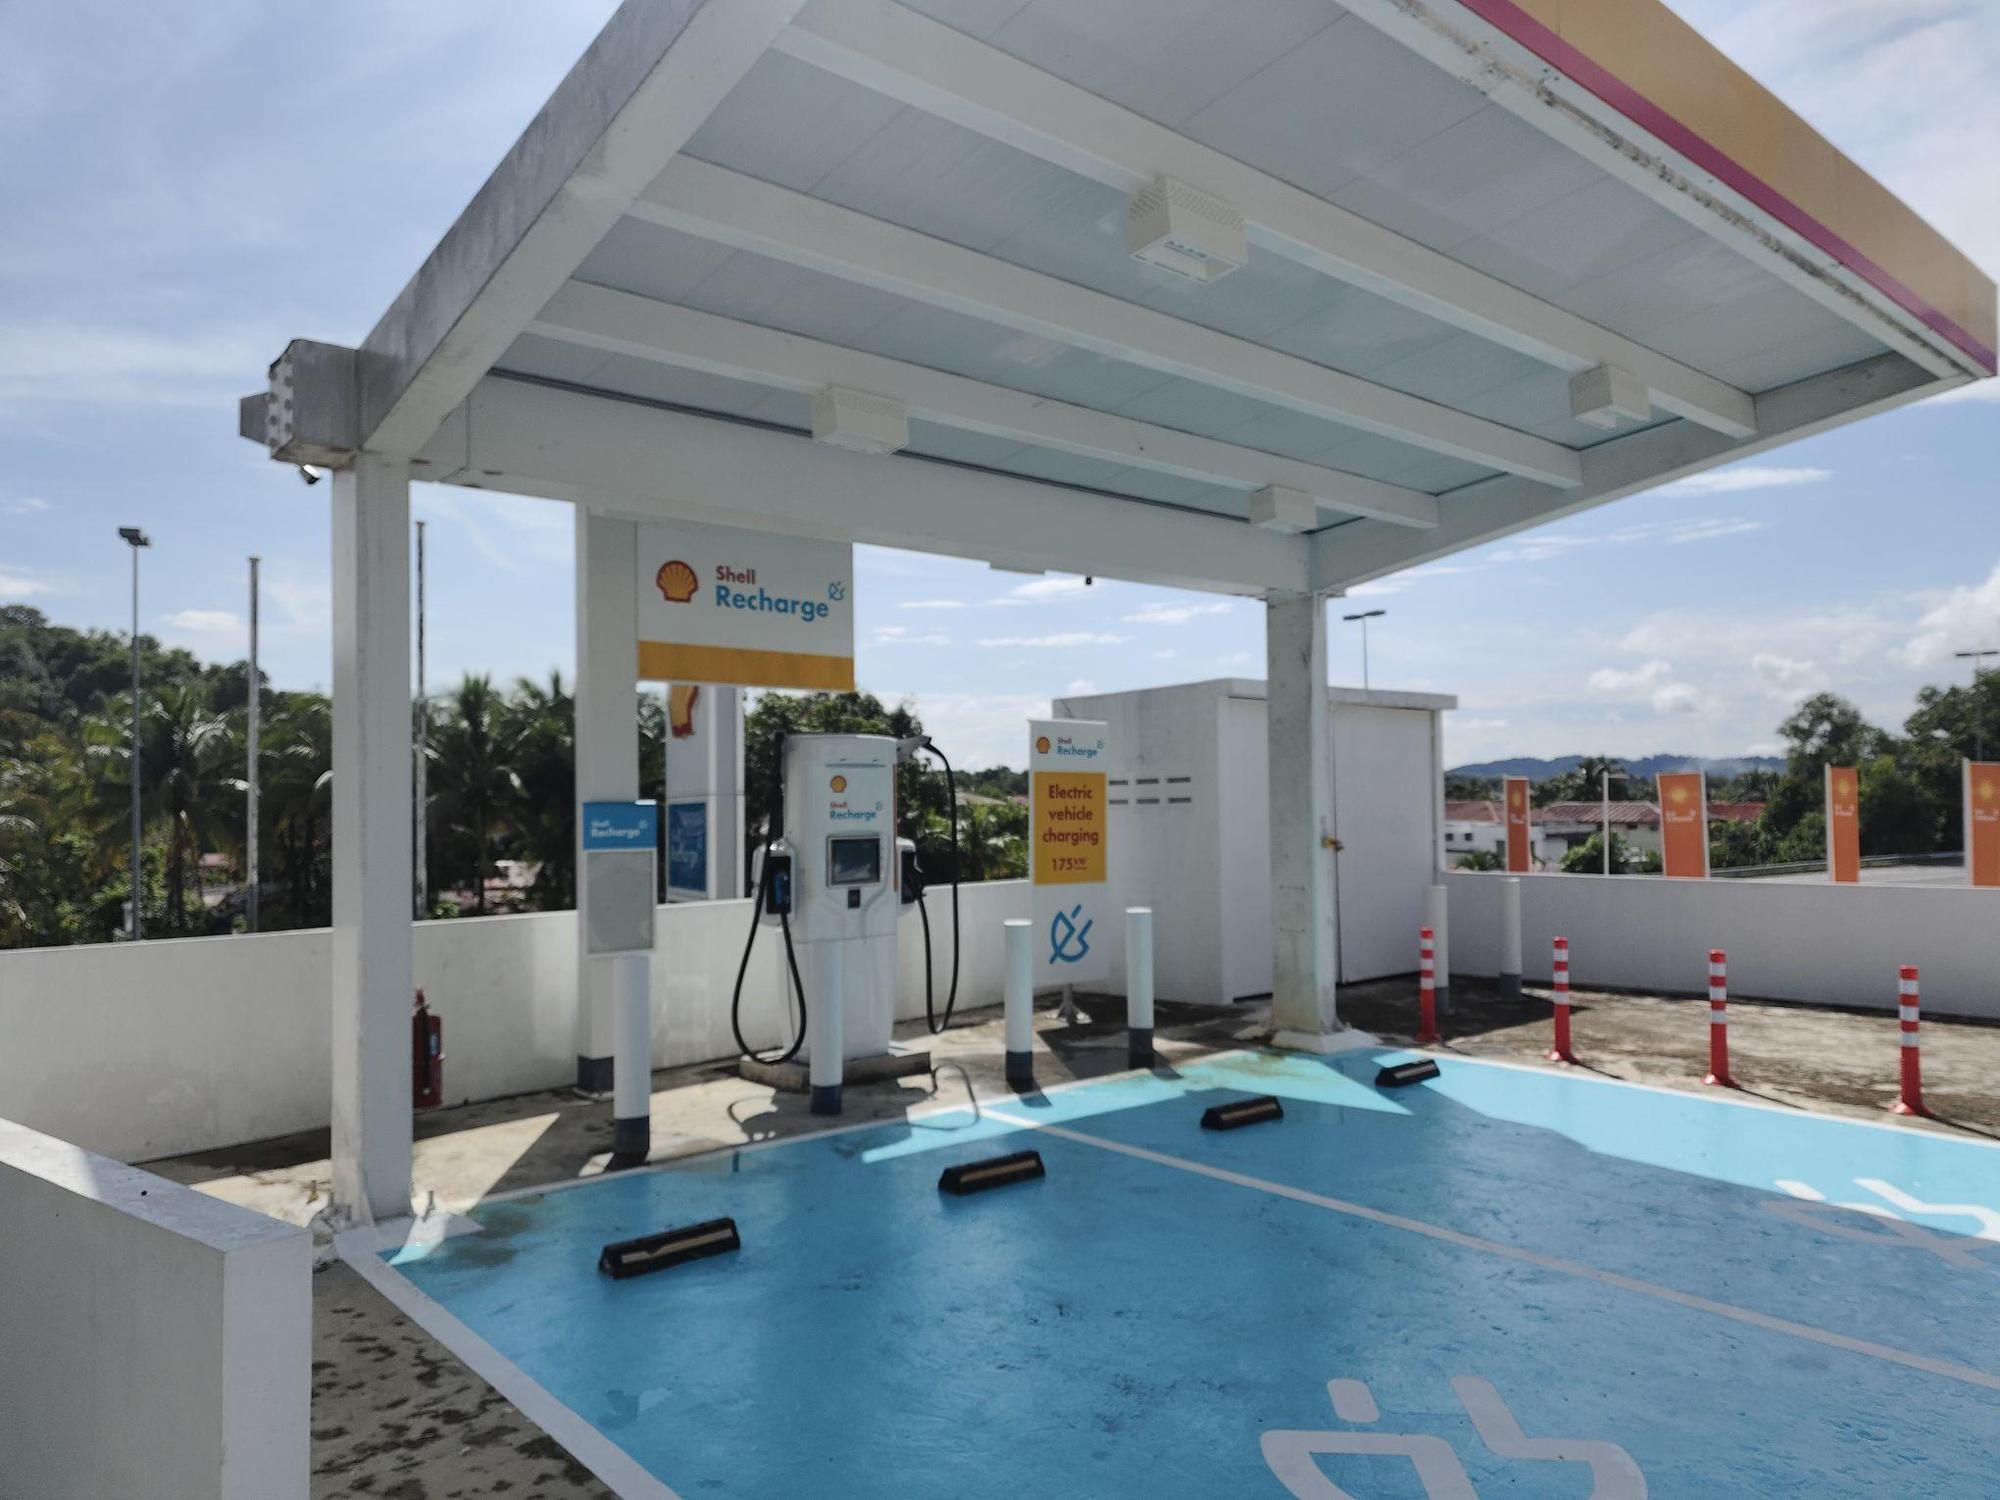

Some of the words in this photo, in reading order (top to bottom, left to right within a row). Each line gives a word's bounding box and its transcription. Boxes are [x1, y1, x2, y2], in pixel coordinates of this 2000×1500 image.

[716, 565, 756, 585] Shell
[715, 585, 829, 622] Recharge
[1057, 737, 1073, 745] Shell
[1057, 745, 1098, 758] Recharge
[1048, 784, 1093, 799] Electric
[830, 809, 876, 821] Recharge
[1048, 805, 1093, 821] vehicle
[1042, 827, 1099, 846] charging
